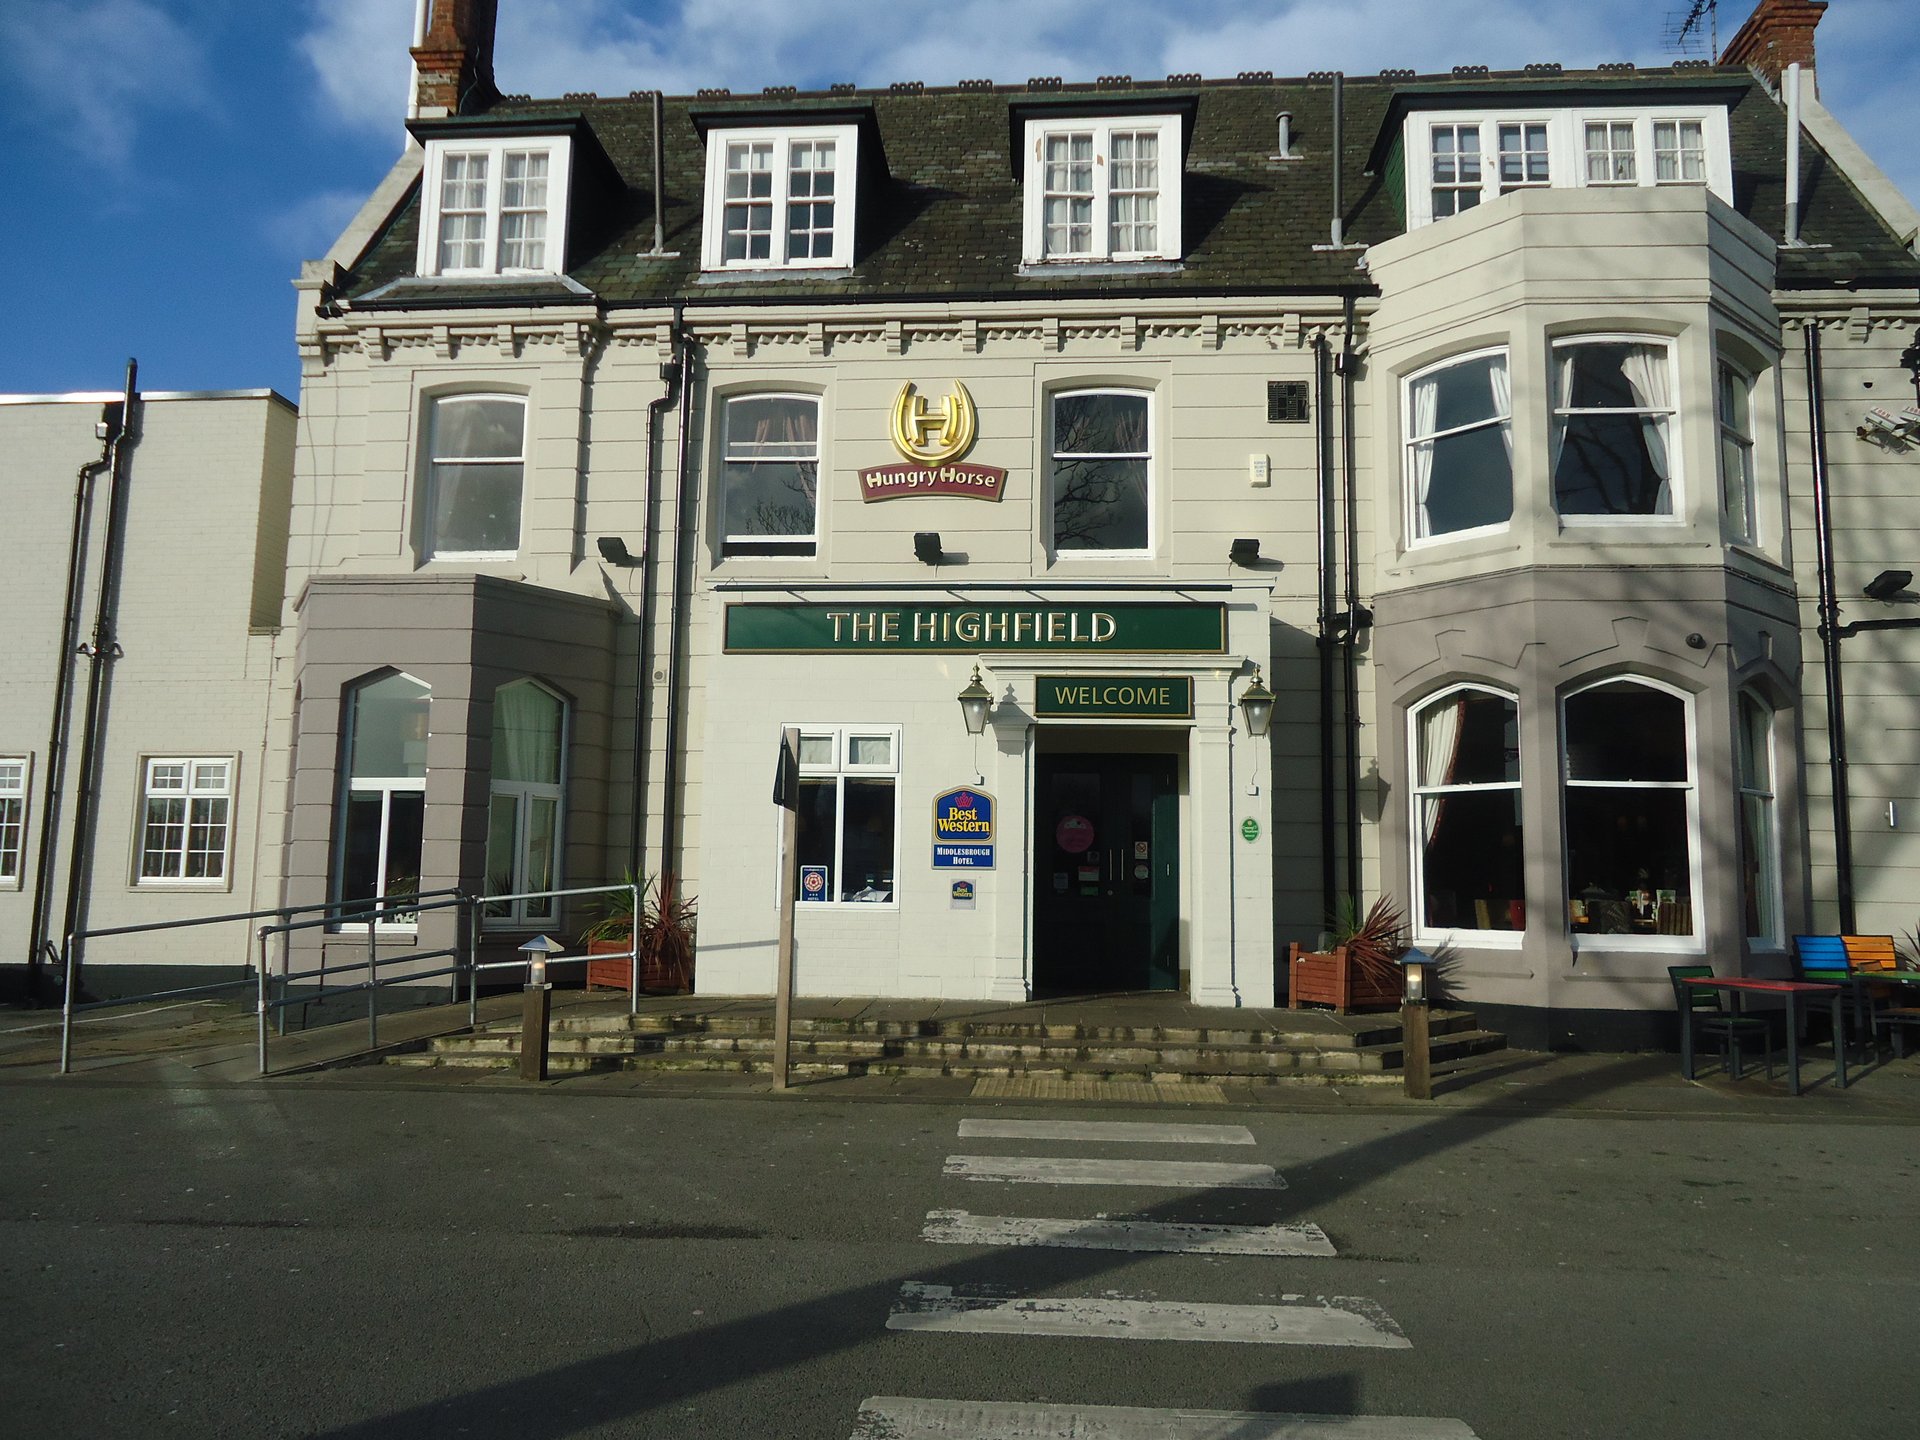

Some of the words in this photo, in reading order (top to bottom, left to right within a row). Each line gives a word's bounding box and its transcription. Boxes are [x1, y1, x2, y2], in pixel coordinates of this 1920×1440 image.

[866, 470, 937, 488] Hungry
[940, 467, 995, 487] Horse
[827, 612, 900, 642] THE
[914, 612, 1117, 643] HIGHFIELD
[1055, 686, 1170, 706] WELCOME
[949, 807, 977, 820] Best
[938, 819, 990, 831] Western
[937, 847, 990, 855] MIDDLESBROUGH
[953, 857, 974, 865] HOTEL
